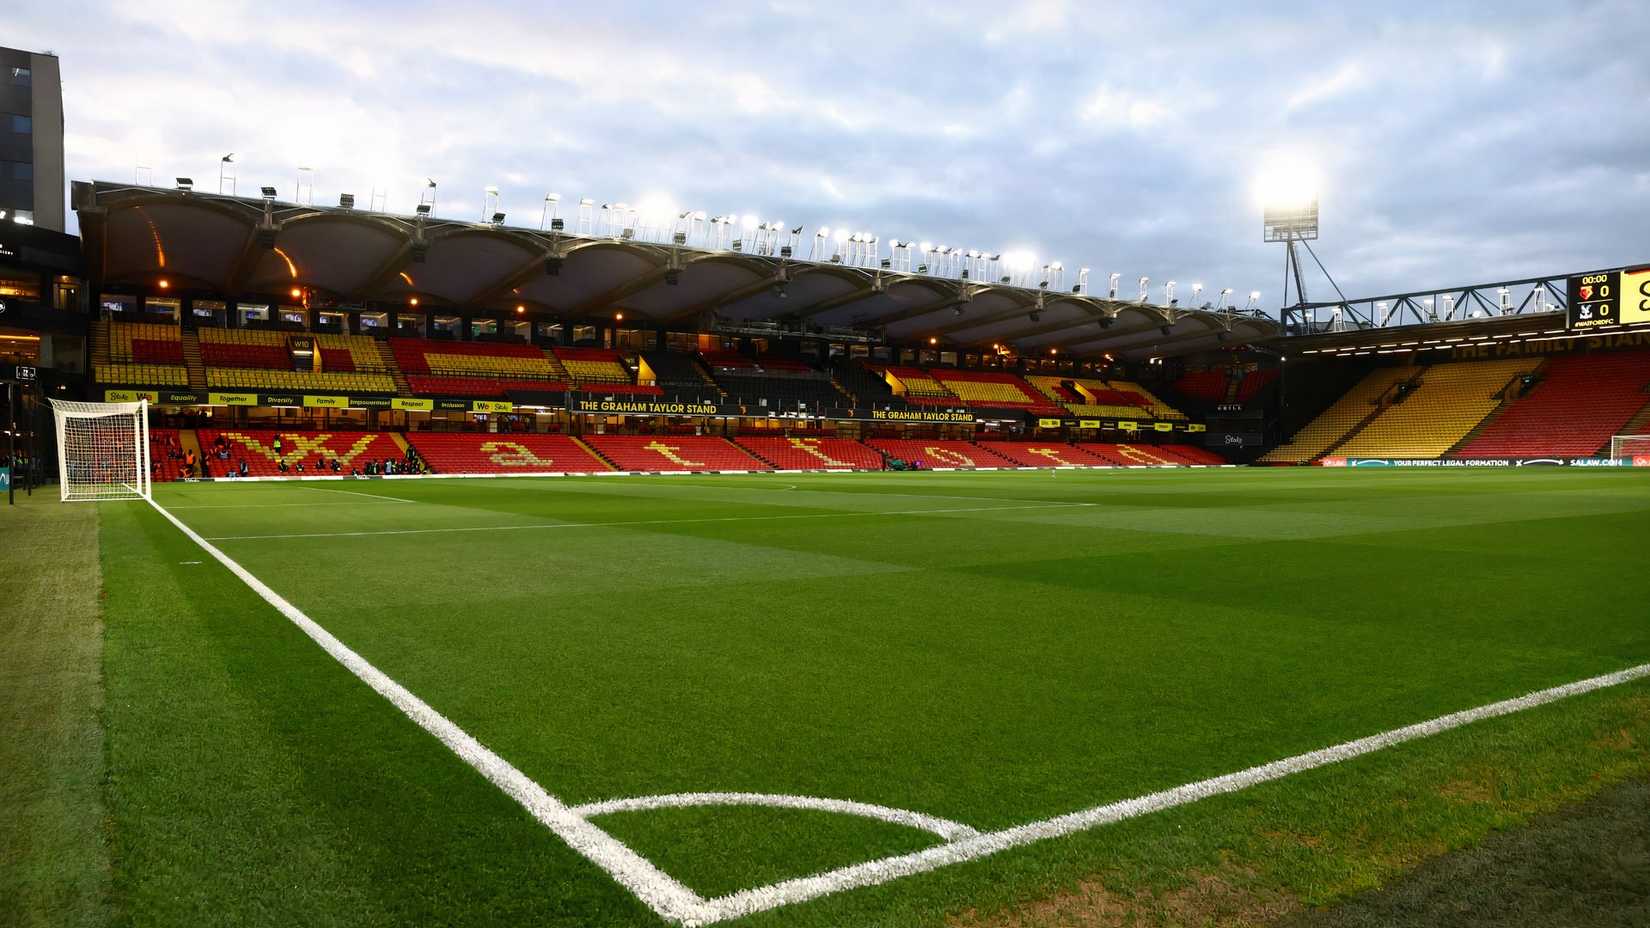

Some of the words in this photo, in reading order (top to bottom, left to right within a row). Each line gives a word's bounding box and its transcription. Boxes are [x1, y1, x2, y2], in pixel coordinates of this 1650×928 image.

[1582, 274, 1608, 285] 00:00
[1600, 285, 1609, 297] 0
[1600, 304, 1609, 316] 0
[1575, 318, 1614, 327] #WATFORDFC
[580, 401, 599, 411] THE
[601, 401, 647, 412] GRAHAM
[649, 403, 685, 414] TAYLOR
[686, 404, 717, 415] STAND
[872, 410, 886, 419] THE
[887, 411, 922, 420] GRAHAM
[923, 412, 950, 421] TAYLOR
[951, 413, 973, 422] STAND
[1465, 459, 1509, 467] FORMATION
